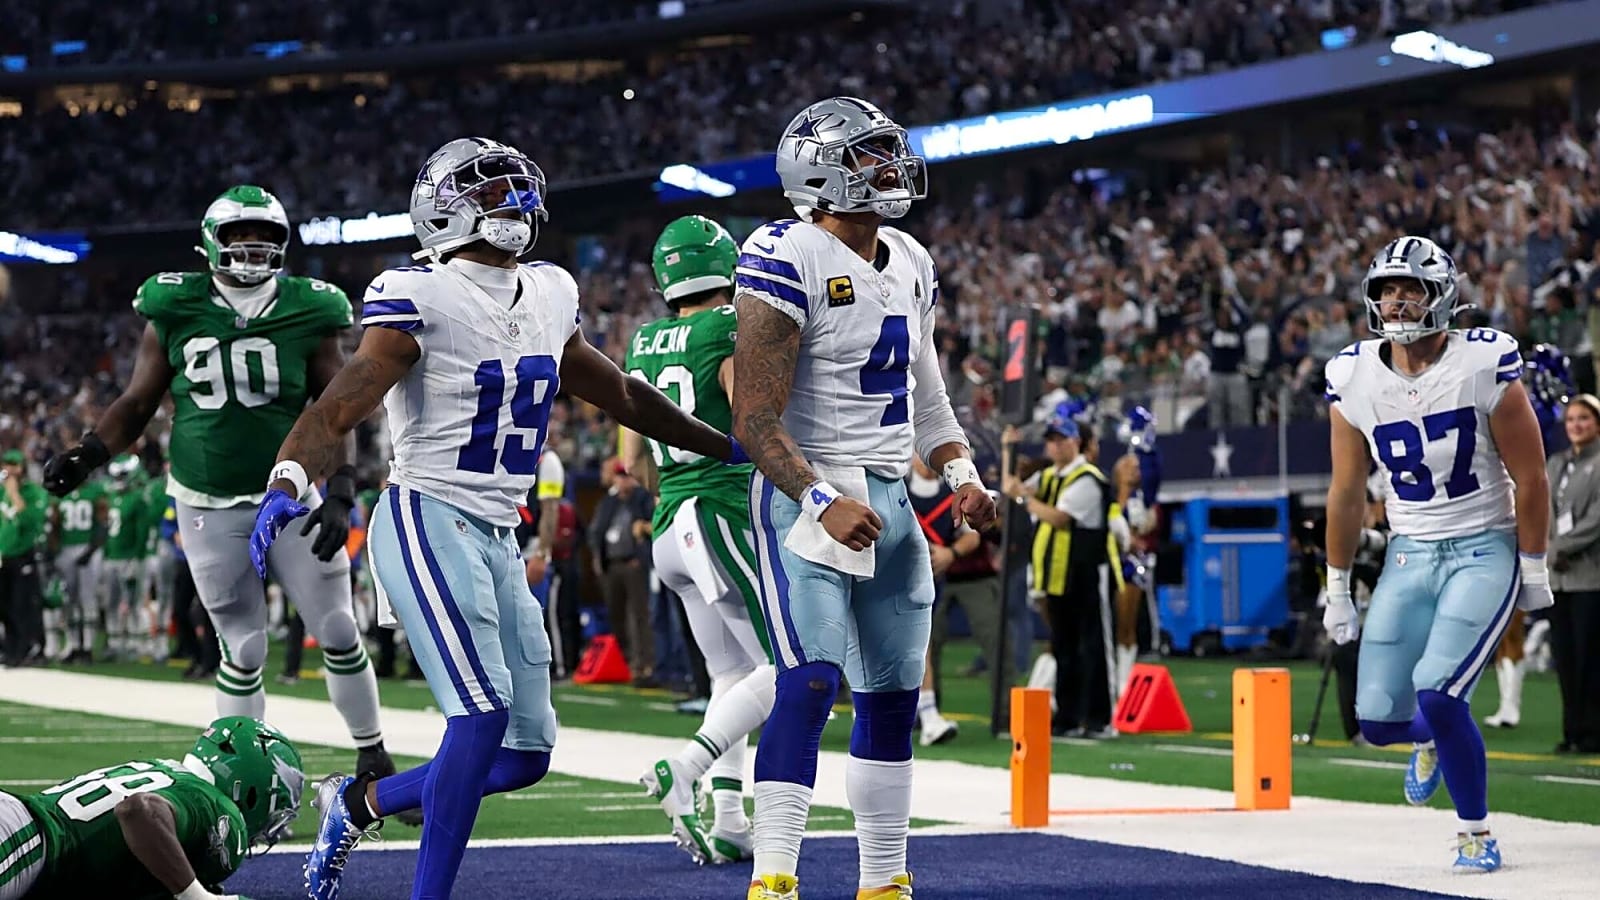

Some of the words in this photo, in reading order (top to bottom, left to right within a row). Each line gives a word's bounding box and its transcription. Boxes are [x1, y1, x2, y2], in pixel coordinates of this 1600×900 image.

[829, 278, 853, 299] C
[182, 336, 280, 410] 90
[859, 315, 910, 427] 4
[1004, 319, 1027, 382] 2
[456, 354, 560, 476] 19
[1372, 406, 1481, 502] 87
[810, 487, 833, 506] 4
